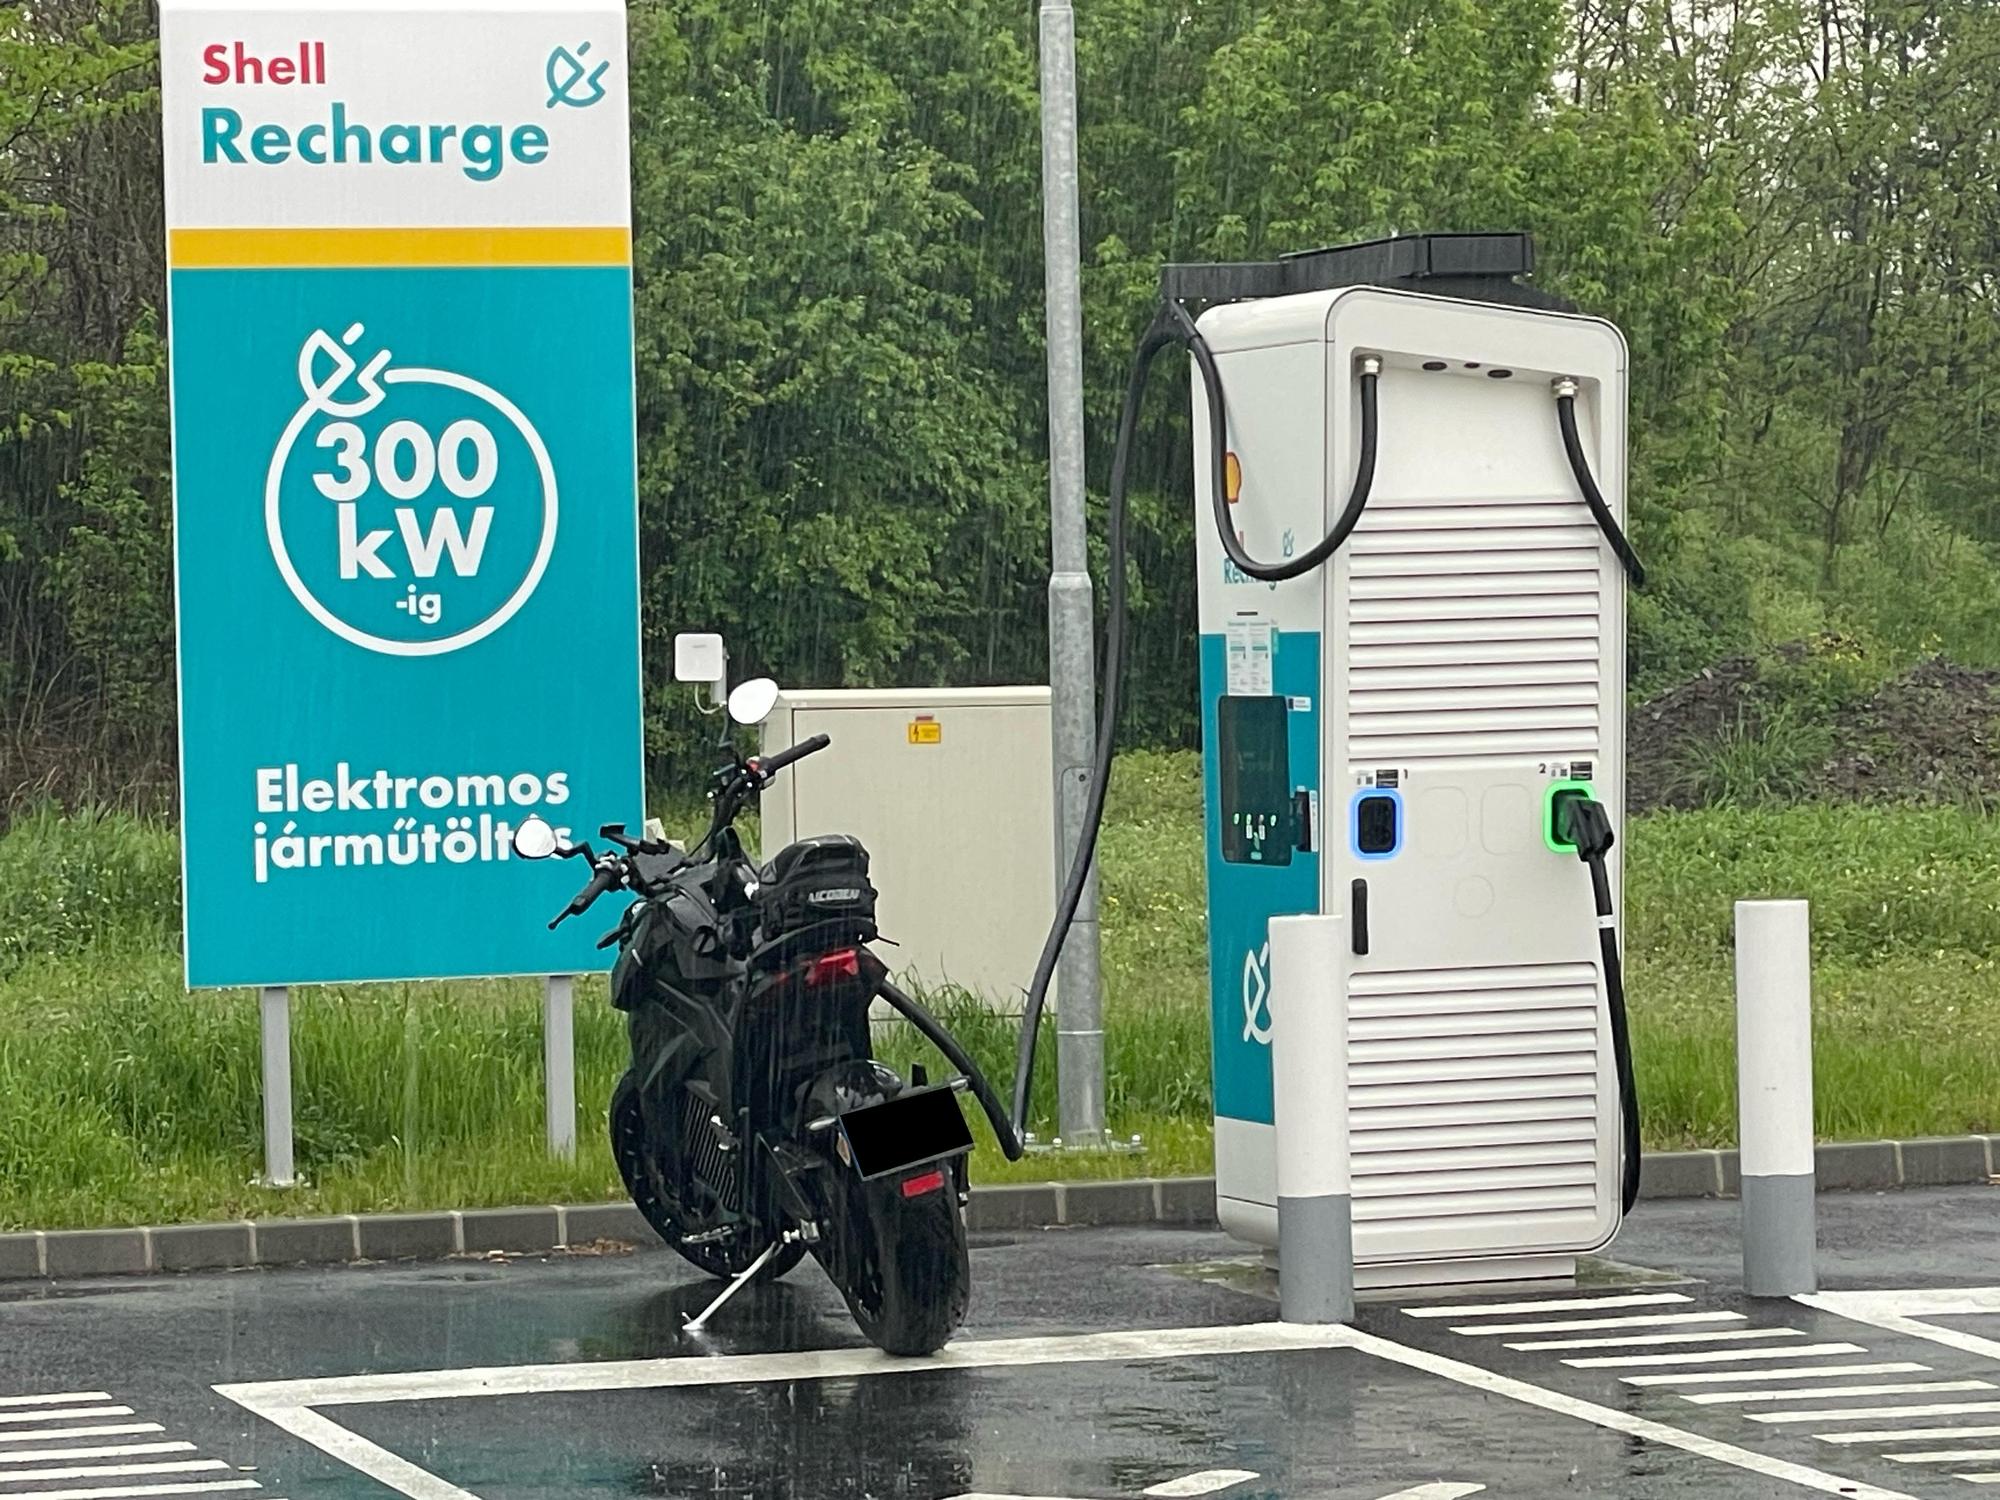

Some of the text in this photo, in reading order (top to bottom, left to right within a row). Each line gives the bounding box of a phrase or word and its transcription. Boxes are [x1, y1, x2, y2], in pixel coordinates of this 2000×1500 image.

[202, 41, 326, 85] Shell
[201, 102, 549, 182] Recharge
[312, 419, 498, 502] 300
[338, 502, 495, 579] kW
[396, 583, 442, 624] -ig
[256, 761, 570, 813] Elektromos
[1539, 762, 1546, 774] 2
[253, 813, 574, 883] járműtölts
